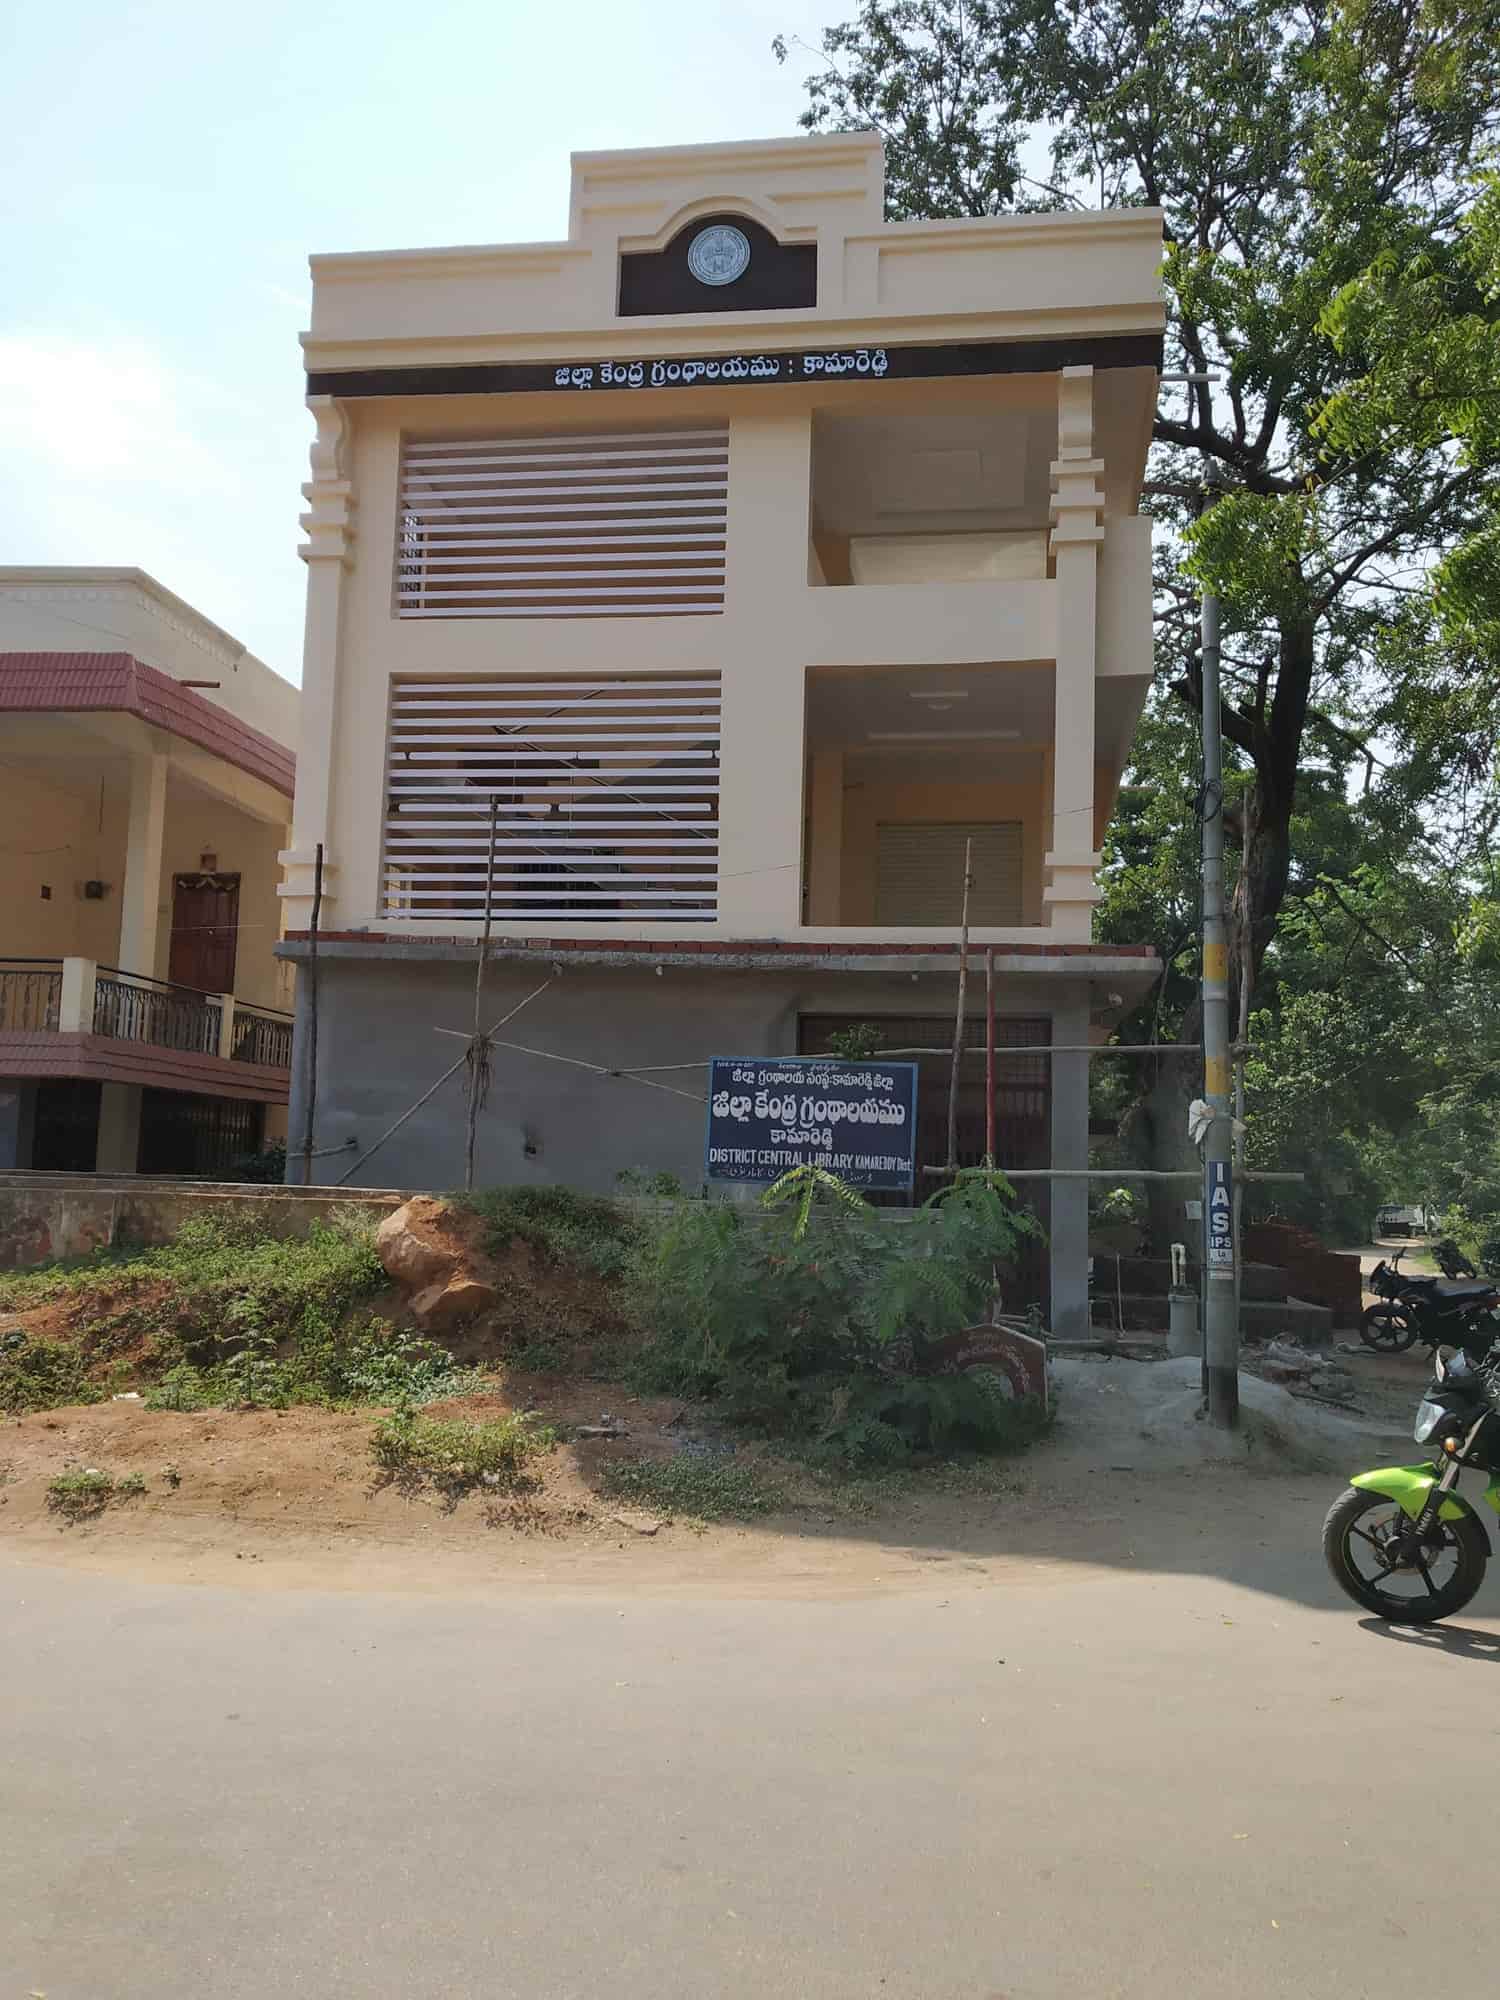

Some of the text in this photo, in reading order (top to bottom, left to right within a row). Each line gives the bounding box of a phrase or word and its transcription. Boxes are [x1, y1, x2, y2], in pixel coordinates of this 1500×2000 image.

[555, 367, 593, 390] జిల్లా
[599, 359, 643, 387] కేంద్ర
[712, 1090, 752, 1122] జిల్లా
[754, 1088, 797, 1126] కేంద్ర
[770, 1127, 833, 1150] కామారెడ్డి
[709, 1148, 757, 1164] DISTRICT
[758, 1150, 802, 1166] CENTRAL
[808, 1151, 853, 1169] LIBRARY
[855, 1154, 895, 1171] KAMAREDDY
[1210, 1236, 1232, 1248] IPS
